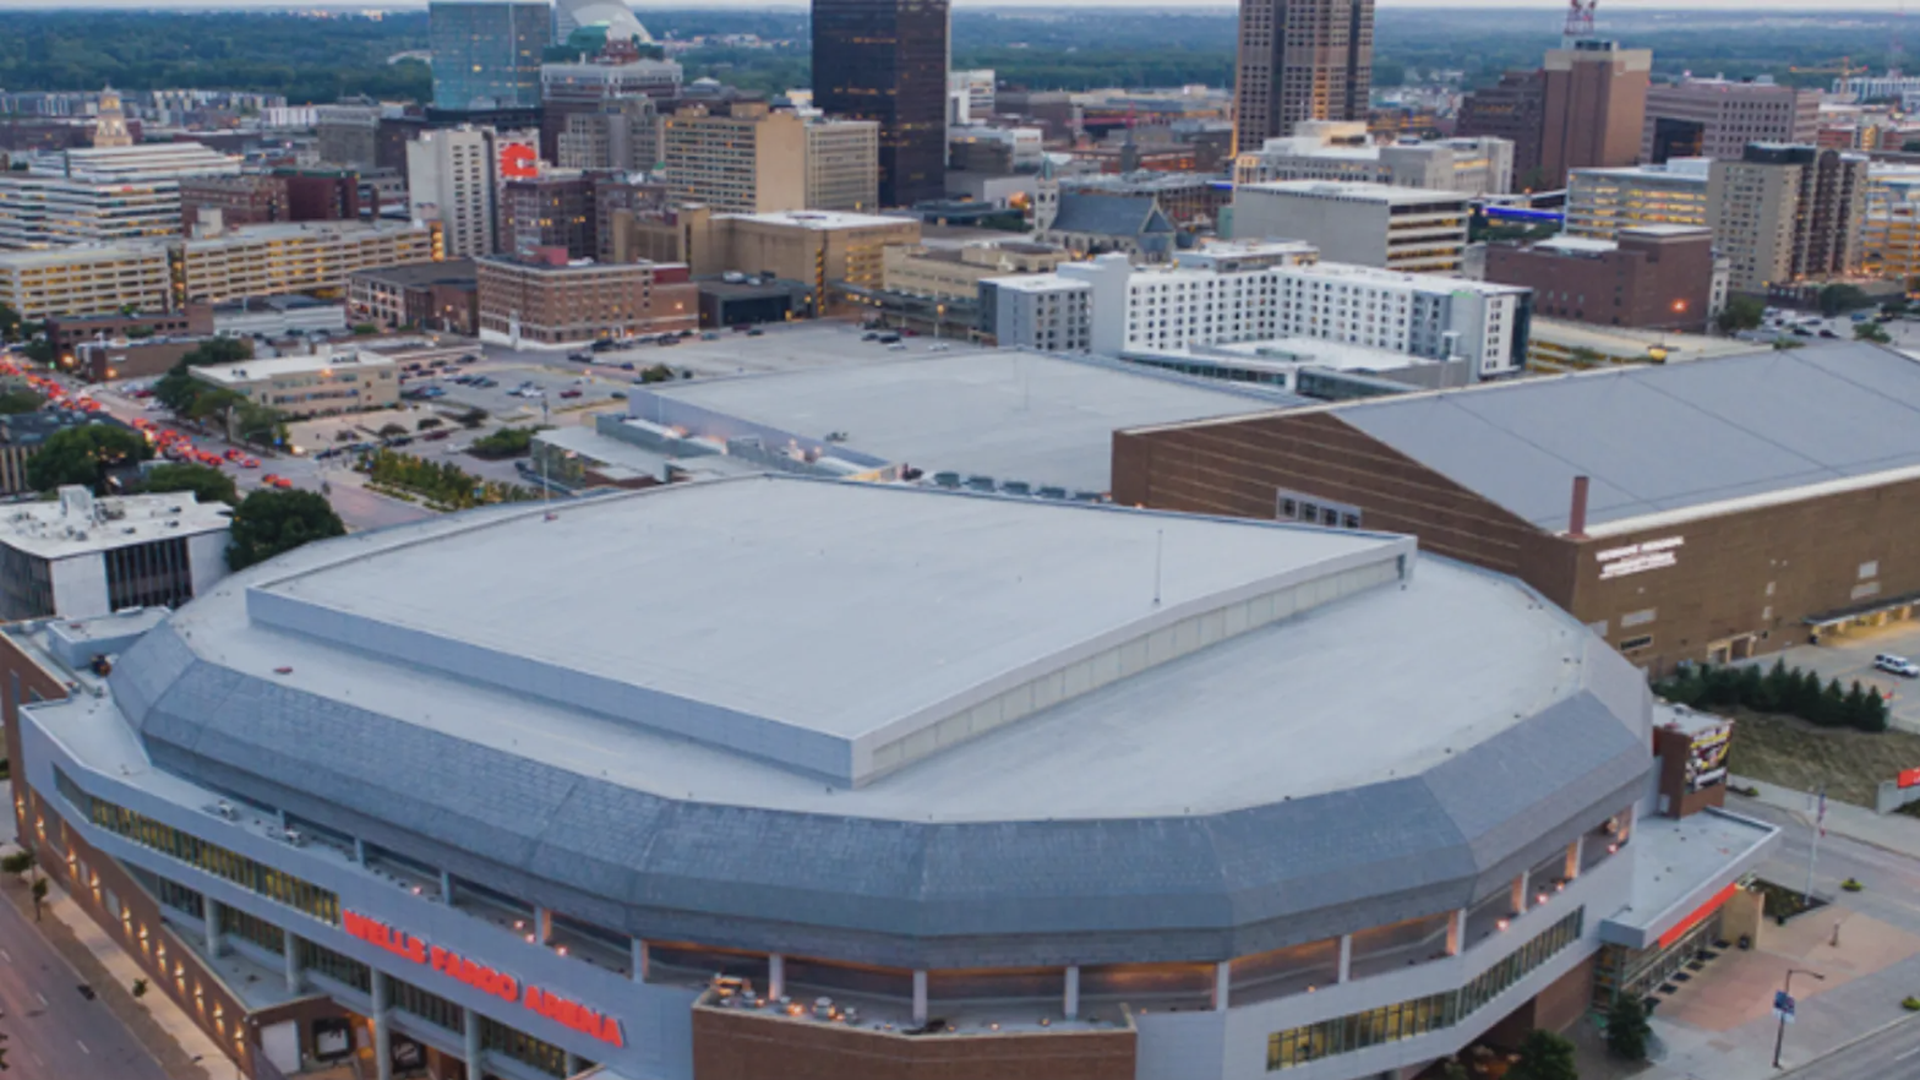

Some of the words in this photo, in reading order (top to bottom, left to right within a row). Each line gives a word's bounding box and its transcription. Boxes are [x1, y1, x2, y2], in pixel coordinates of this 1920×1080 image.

[343, 909, 427, 964] WELLS
[430, 945, 518, 1003] FARGO
[524, 985, 623, 1048] ARENA
